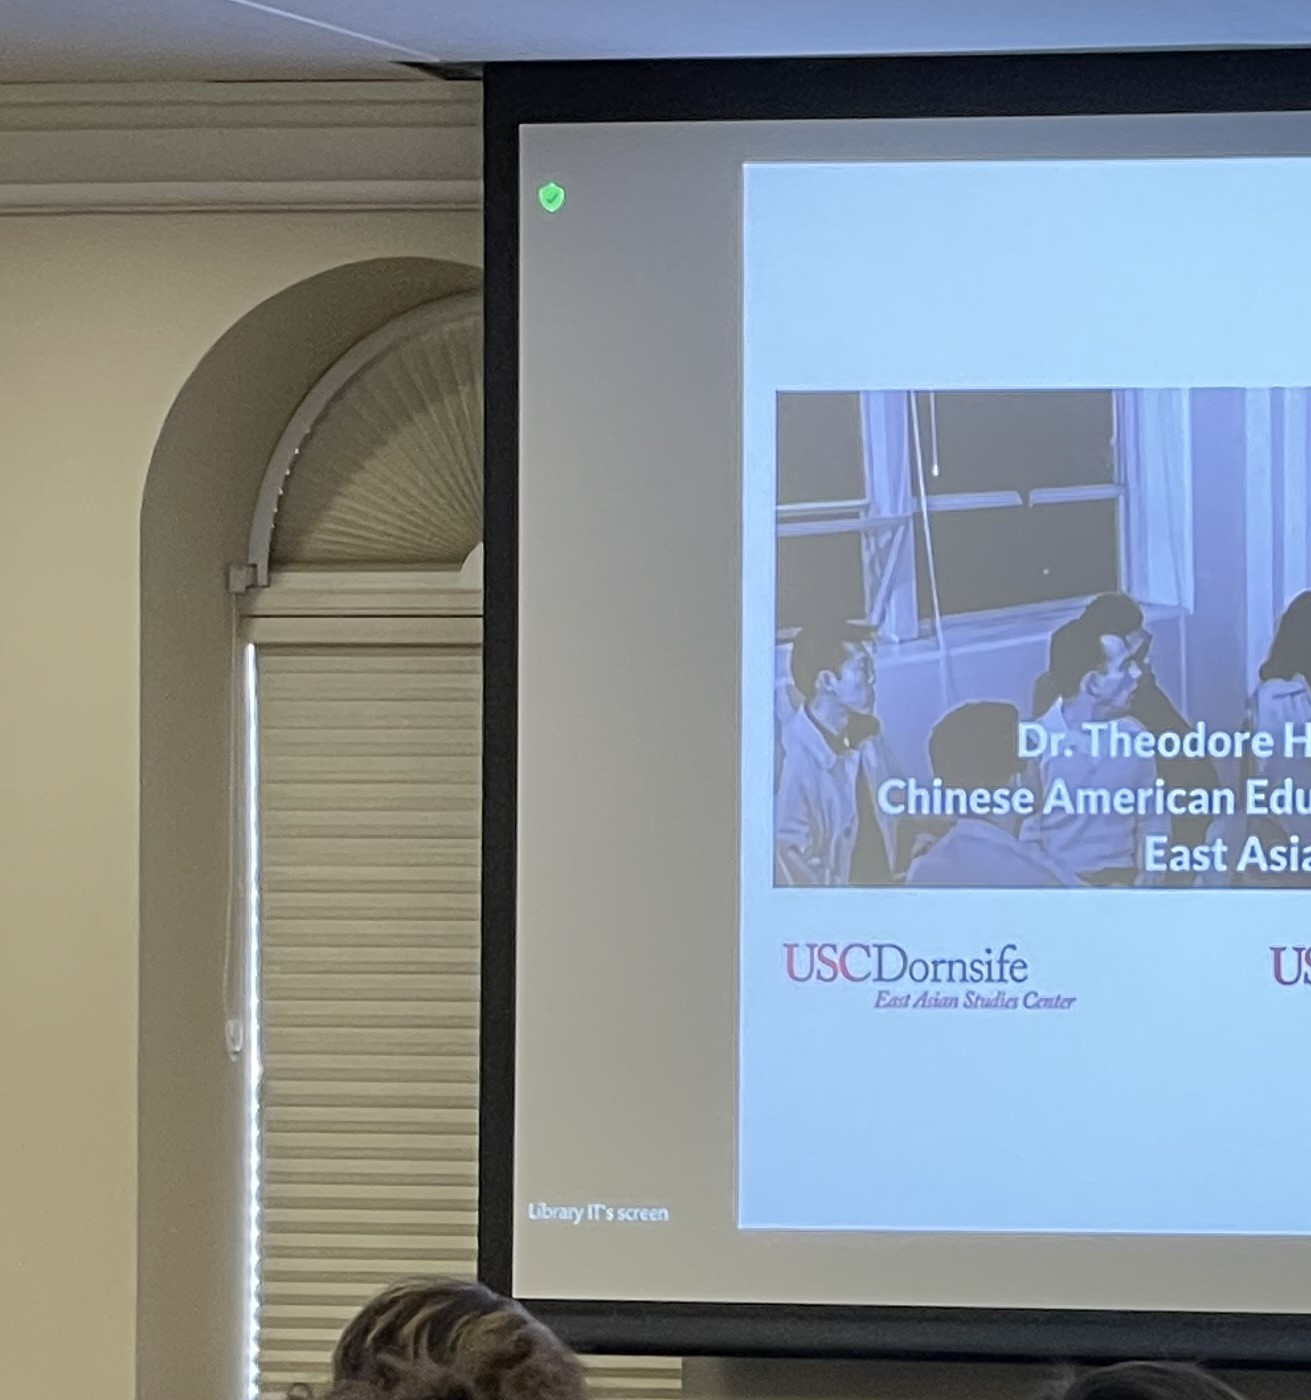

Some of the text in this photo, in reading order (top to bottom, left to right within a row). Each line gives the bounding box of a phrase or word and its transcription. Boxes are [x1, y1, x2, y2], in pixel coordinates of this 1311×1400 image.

[1017, 722, 1073, 758] Dr.
[1083, 722, 1274, 759] Theodore
[877, 778, 1034, 816] Chinese
[1043, 780, 1235, 816] American
[1145, 836, 1228, 872] East
[874, 990, 1077, 1010] East Asian Studies Center
[527, 1203, 670, 1225] Library IT's screen
